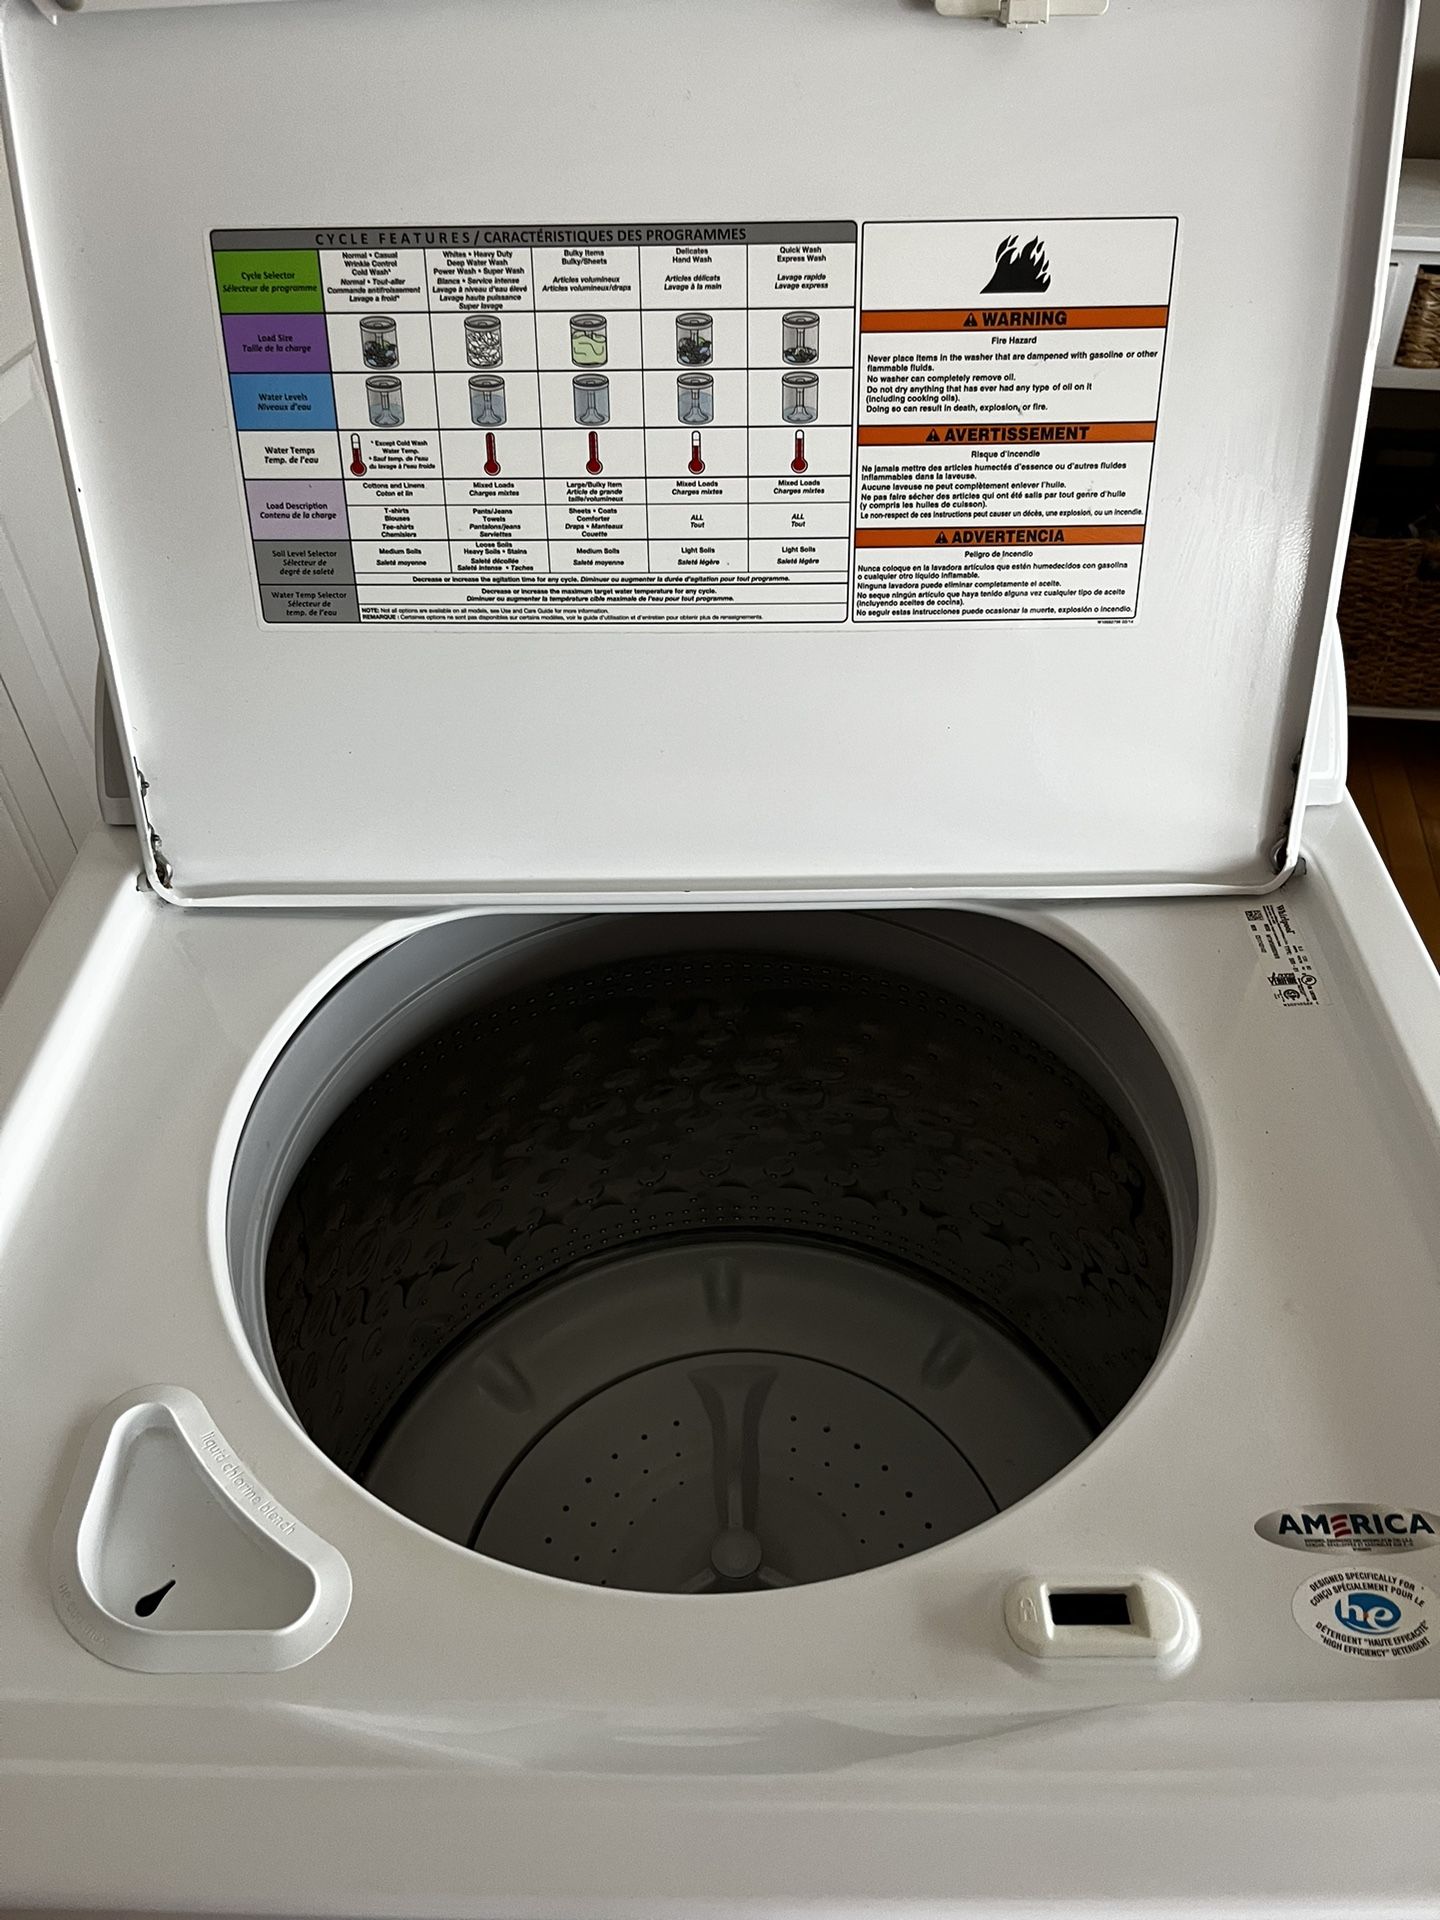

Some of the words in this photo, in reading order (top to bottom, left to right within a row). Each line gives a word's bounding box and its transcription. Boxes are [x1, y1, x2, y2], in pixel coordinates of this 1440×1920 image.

[315, 233, 368, 245] CYCLE
[617, 229, 642, 242] DES
[646, 228, 746, 241] PROGRAMMES
[563, 249, 583, 258] Bulky
[584, 249, 605, 257] Items
[675, 247, 709, 255] Delicates
[779, 246, 801, 254] Quick
[801, 246, 822, 254] Wash
[342, 251, 368, 259] Normal
[374, 251, 398, 259] Casual
[442, 250, 467, 258] Whites
[473, 250, 495, 261] Heavy
[496, 250, 513, 259] Duty
[692, 255, 713, 263] Wash
[777, 254, 805, 264] Express
[806, 254, 827, 262] Wash
[561, 257, 608, 266] Bulky/Sheets
[241, 271, 262, 281] Cycle
[263, 271, 295, 280] Selector
[693, 274, 721, 282] délicats
[777, 273, 803, 282] Lavage
[803, 273, 827, 282] rapide
[222, 284, 258, 293] Sélecteur
[260, 284, 270, 293] de
[271, 283, 318, 294] programme
[664, 283, 689, 292] Lavage
[774, 282, 800, 291] Lavage
[981, 311, 1067, 327] WARNING
[257, 334, 276, 343] Load
[277, 334, 293, 342] Size
[991, 336, 1007, 345] Fire
[1009, 336, 1037, 345] Hazard
[242, 344, 263, 353] Taille
[264, 344, 274, 353] de
[276, 344, 284, 352] la
[284, 344, 312, 354] charge
[867, 354, 891, 363] Never
[892, 354, 915, 364] place
[916, 354, 938, 362] items
[939, 353, 948, 362] in
[964, 353, 993, 361] washer
[995, 352, 1011, 361] that
[1026, 351, 1069, 362] dampened
[1070, 351, 1088, 359] with
[1089, 350, 1124, 361] gasoline
[1136, 350, 1158, 358] other
[867, 363, 909, 372] flammable
[910, 363, 935, 372] fluids.
[867, 375, 879, 383] No
[880, 375, 909, 383] washer
[927, 374, 971, 384] completely
[1003, 373, 1016, 381] oil.
[866, 385, 878, 394] Do
[879, 386, 893, 394] not
[894, 385, 908, 395] dry
[909, 385, 945, 395] anything
[946, 385, 962, 393] that
[963, 384, 978, 392] has
[999, 384, 1014, 392] had
[1015, 385, 1031, 393] any
[1032, 384, 1050, 393] type
[1052, 383, 1061, 391] of
[1062, 383, 1073, 391] oil
[1086, 382, 1092, 391] it
[258, 393, 283, 401] Water
[284, 392, 308, 401] Levels
[865, 395, 906, 404] (including
[907, 394, 939, 404] cooking
[940, 394, 960, 403] oils).
[257, 403, 289, 411] Niveaux
[290, 403, 312, 411] d'eau
[866, 405, 890, 415] Doing
[919, 404, 942, 412] result
[944, 404, 952, 412] in
[953, 404, 978, 412] death,
[979, 403, 1021, 413] explosion,
[1032, 403, 1048, 411] fire.
[944, 426, 1090, 442] AVERTISSEMENT
[264, 446, 289, 454] Water
[289, 446, 316, 456] Temps
[264, 456, 287, 465] Temp.
[288, 456, 299, 464] de
[300, 456, 319, 464] l'eau
[971, 450, 999, 462] Risque
[999, 450, 1041, 458] d'incendie
[676, 480, 697, 488] Mixed
[671, 488, 700, 497] Charges
[266, 502, 285, 510] Load
[285, 502, 328, 511] Description
[259, 511, 291, 519] Contenu
[291, 511, 302, 519] de
[303, 511, 310, 519] la
[311, 511, 337, 520] charge
[690, 521, 705, 529] Tout
[952, 529, 1065, 544] ADVERTENCIA
[272, 550, 286, 558] Soil
[286, 550, 306, 558] Level
[307, 550, 337, 558] Selector
[964, 550, 991, 560] Peligro
[991, 550, 1001, 558] de
[1002, 550, 1034, 558] incendio
[283, 558, 317, 567] Sélecteur
[317, 559, 327, 567] de
[279, 568, 301, 577] degré
[270, 591, 294, 599] Water
[295, 591, 316, 600] Temp
[317, 591, 347, 599] Selector
[287, 600, 321, 608] Sélecteur
[321, 600, 331, 608] de
[286, 609, 307, 617] temp.
[201, 1431, 231, 1463] liquid
[222, 1464, 261, 1504] chlorine
[258, 1500, 296, 1535] bleach
[1278, 1513, 1435, 1538] AMERICA
[1309, 1573, 1344, 1592] DESIGNED
[1345, 1572, 1397, 1584] SPECIFICALLY
[1399, 1578, 1416, 1592] FOR
[1310, 1589, 1333, 1607] CONÇU
[1332, 1581, 1388, 1594] SPÉCIALEMENT
[1390, 1585, 1413, 1601] POUR
[1414, 1596, 1425, 1608] LE
[1340, 1592, 1394, 1630] he
